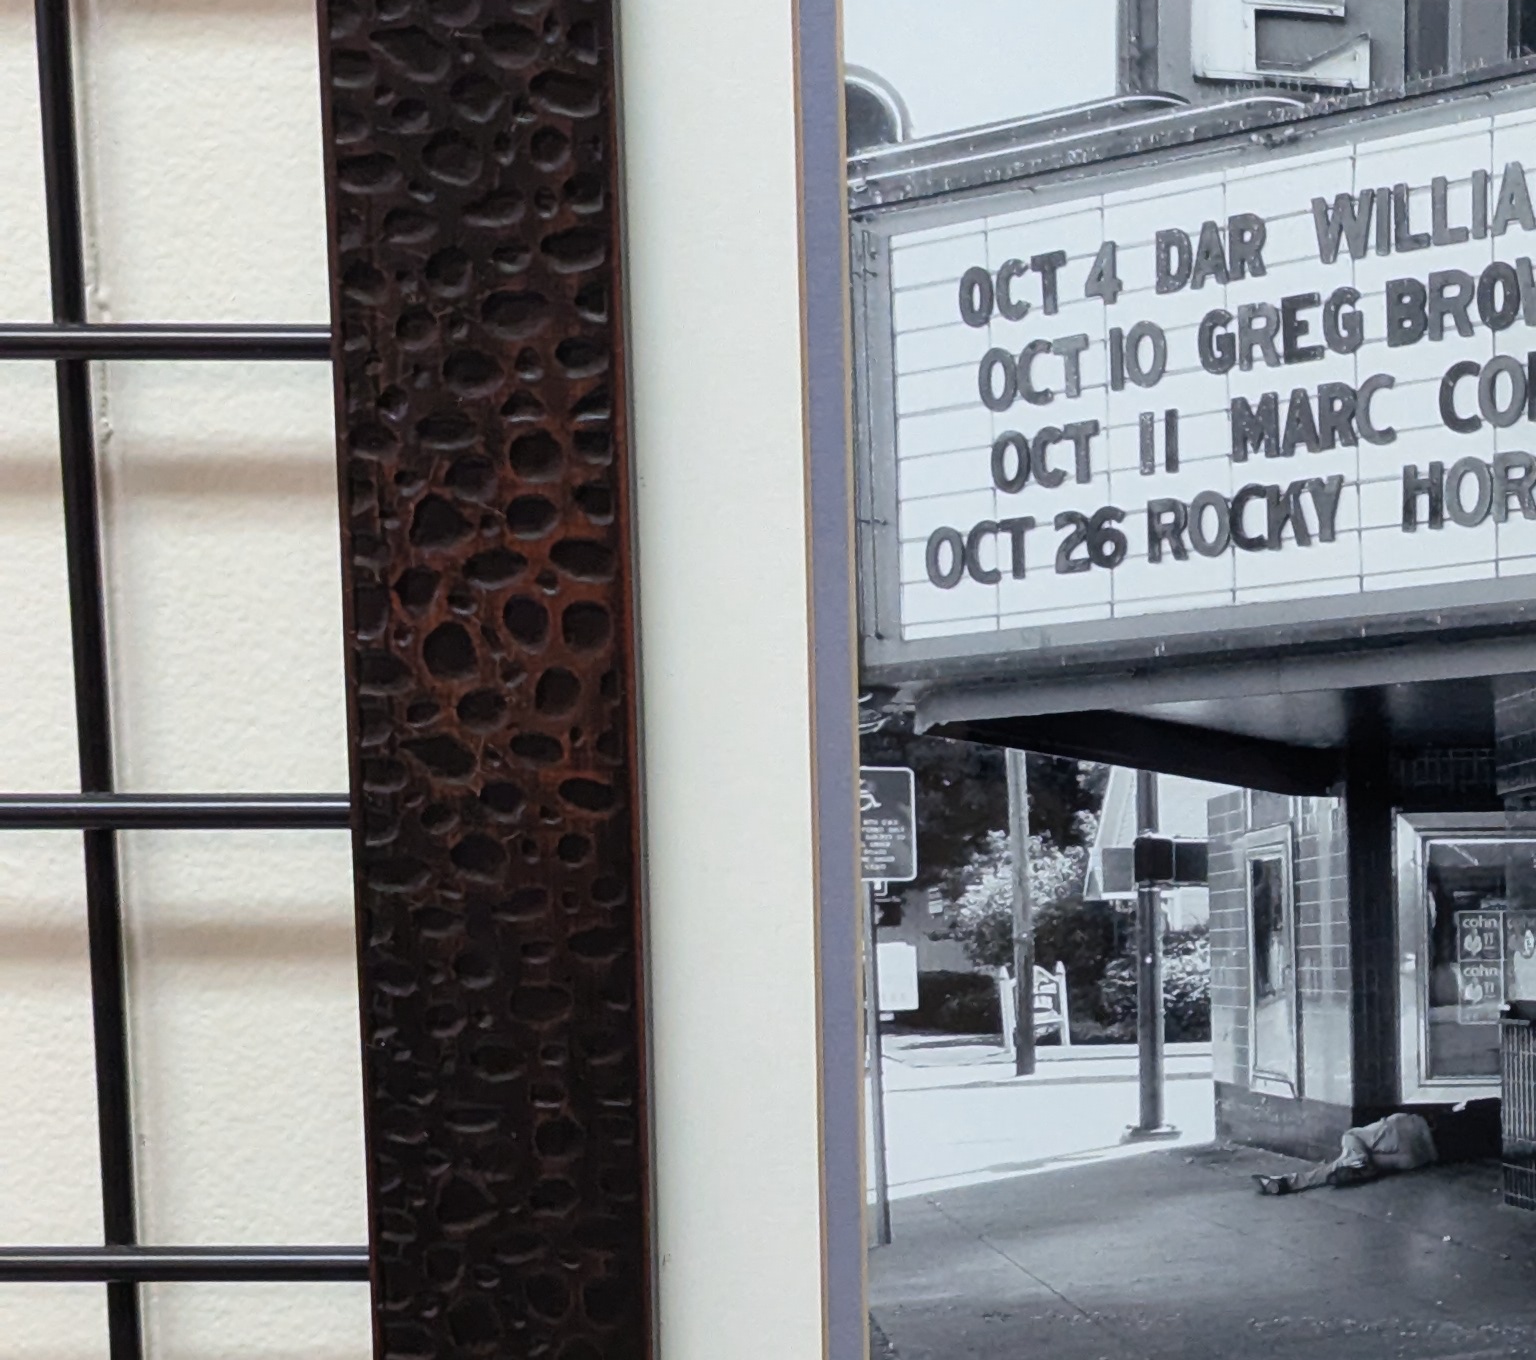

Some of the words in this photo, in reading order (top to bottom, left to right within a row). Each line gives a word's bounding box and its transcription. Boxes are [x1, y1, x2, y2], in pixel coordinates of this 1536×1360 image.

[958, 249, 1067, 329] OCT
[1084, 240, 1124, 306] 4
[1154, 212, 1267, 295] DAR
[978, 332, 1090, 413] OCT
[1108, 320, 1168, 392] 10
[1197, 285, 1365, 376] GREG
[990, 418, 1101, 495] OCT
[1138, 408, 1179, 476] 11
[1230, 372, 1398, 464] MARC
[925, 515, 1036, 590] OCT
[1053, 504, 1128, 575] 26
[1146, 473, 1345, 564] ROCKY
[1462, 914, 1498, 929] cohn
[1463, 964, 1498, 977] cohn
